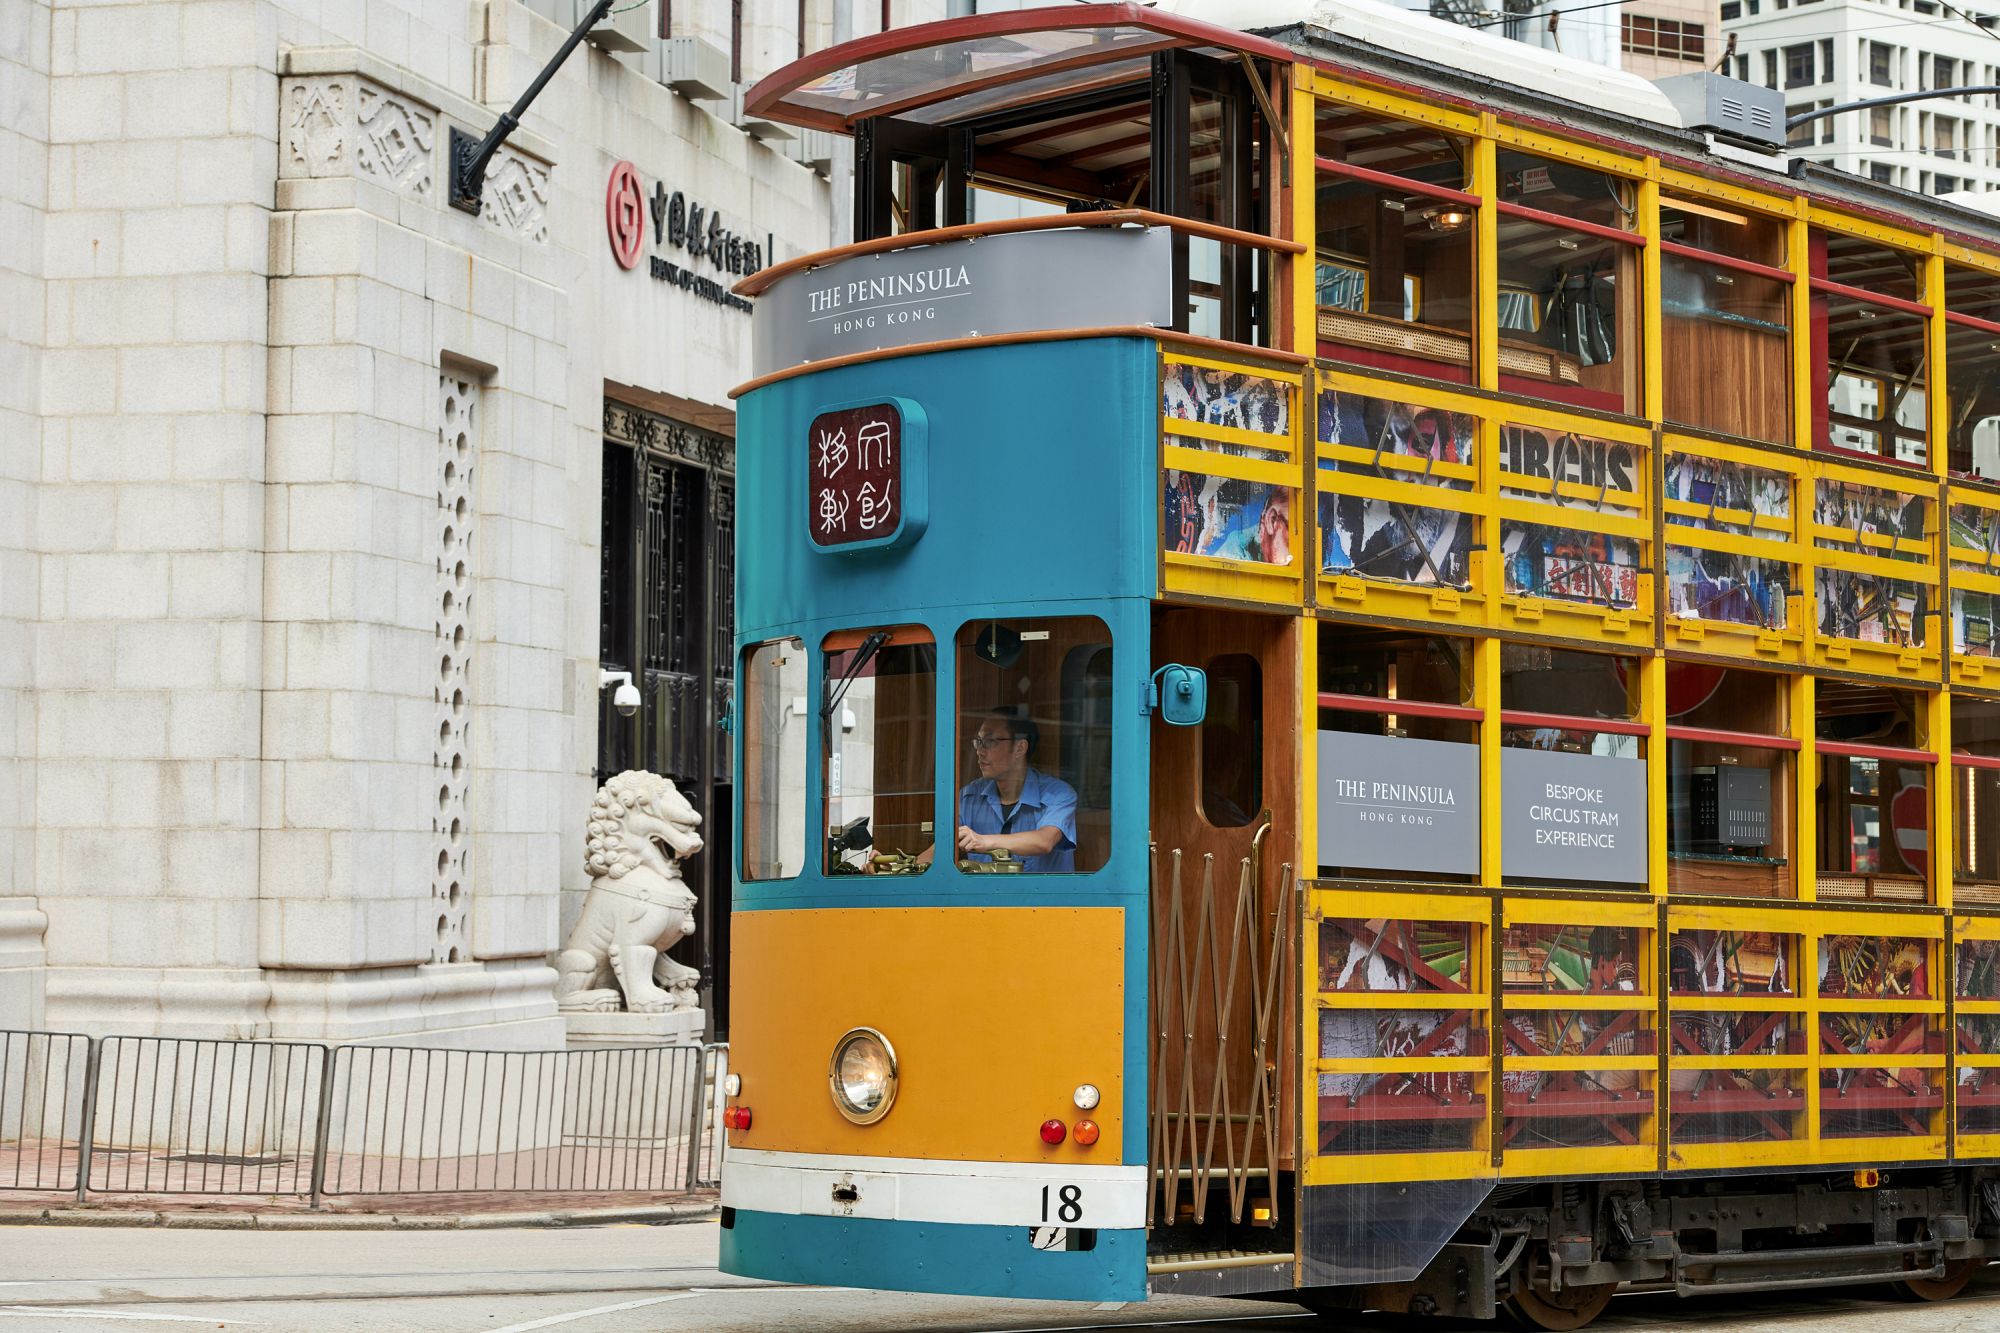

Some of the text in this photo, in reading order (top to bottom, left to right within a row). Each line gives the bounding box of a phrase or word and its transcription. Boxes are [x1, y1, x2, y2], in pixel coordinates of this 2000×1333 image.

[650, 255, 680, 285] BANK
[679, 269, 694, 291] OF
[694, 275, 724, 305] CHINA
[808, 264, 971, 313] THE PENINSULA
[833, 307, 936, 335] HONG KONG
[1499, 424, 1634, 512] IRCUS
[1335, 779, 1456, 806] THE PENINSULA
[1546, 783, 1604, 804] BESPOKE
[1360, 811, 1434, 826] HONG KONG
[1529, 805, 1619, 827] CIRCUS TRAM
[1535, 829, 1616, 849] EXPERIENCE
[1041, 1184, 1083, 1223] 18
